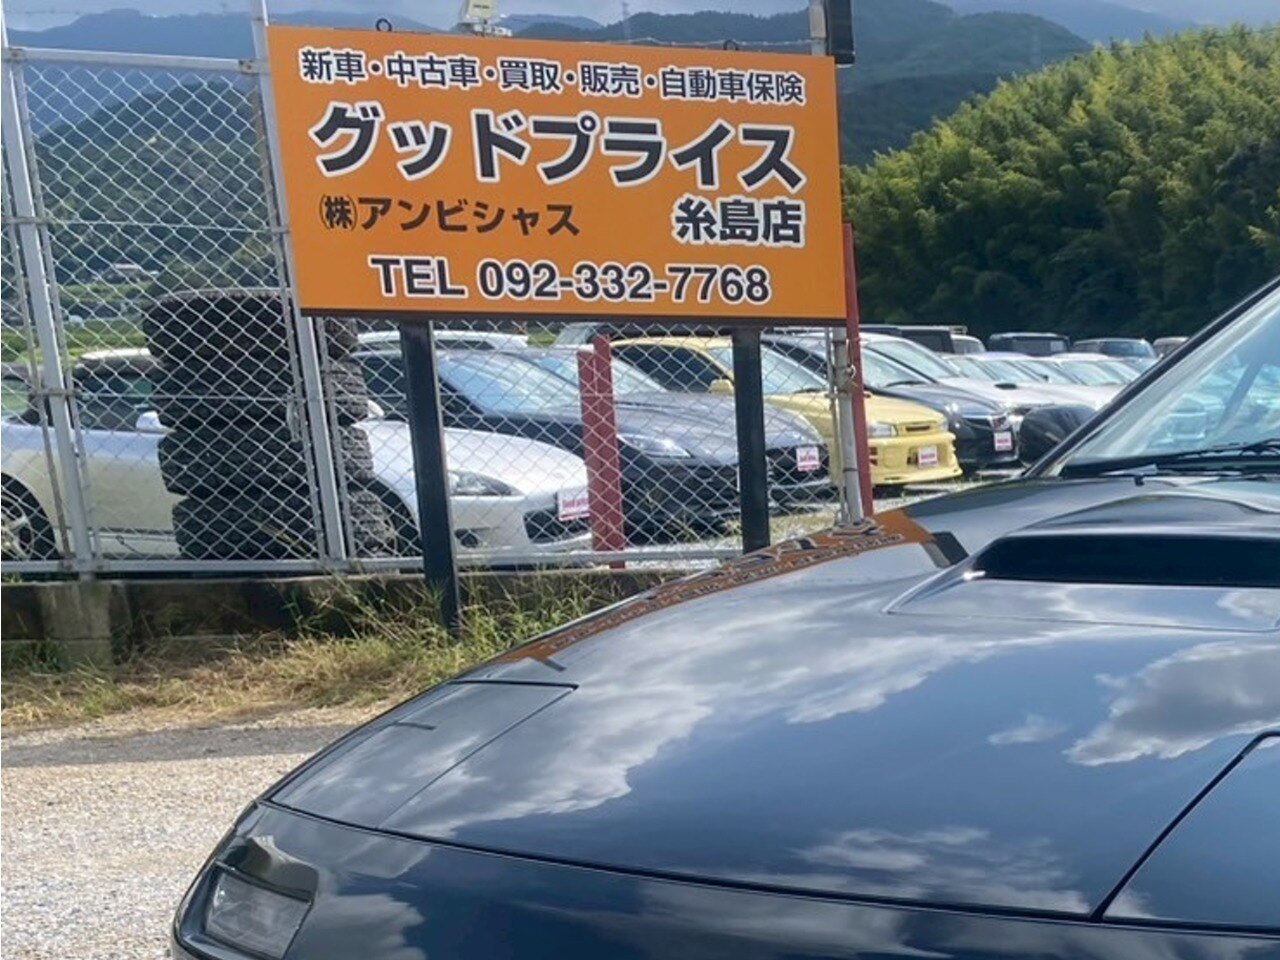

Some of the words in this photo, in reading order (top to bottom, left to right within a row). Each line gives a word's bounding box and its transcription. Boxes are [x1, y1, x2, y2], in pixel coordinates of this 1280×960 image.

[311, 103, 804, 189] グッドプライス
[674, 195, 804, 246] 糸島店
[370, 256, 468, 298] TEL
[478, 259, 771, 303] 092-332-7768
